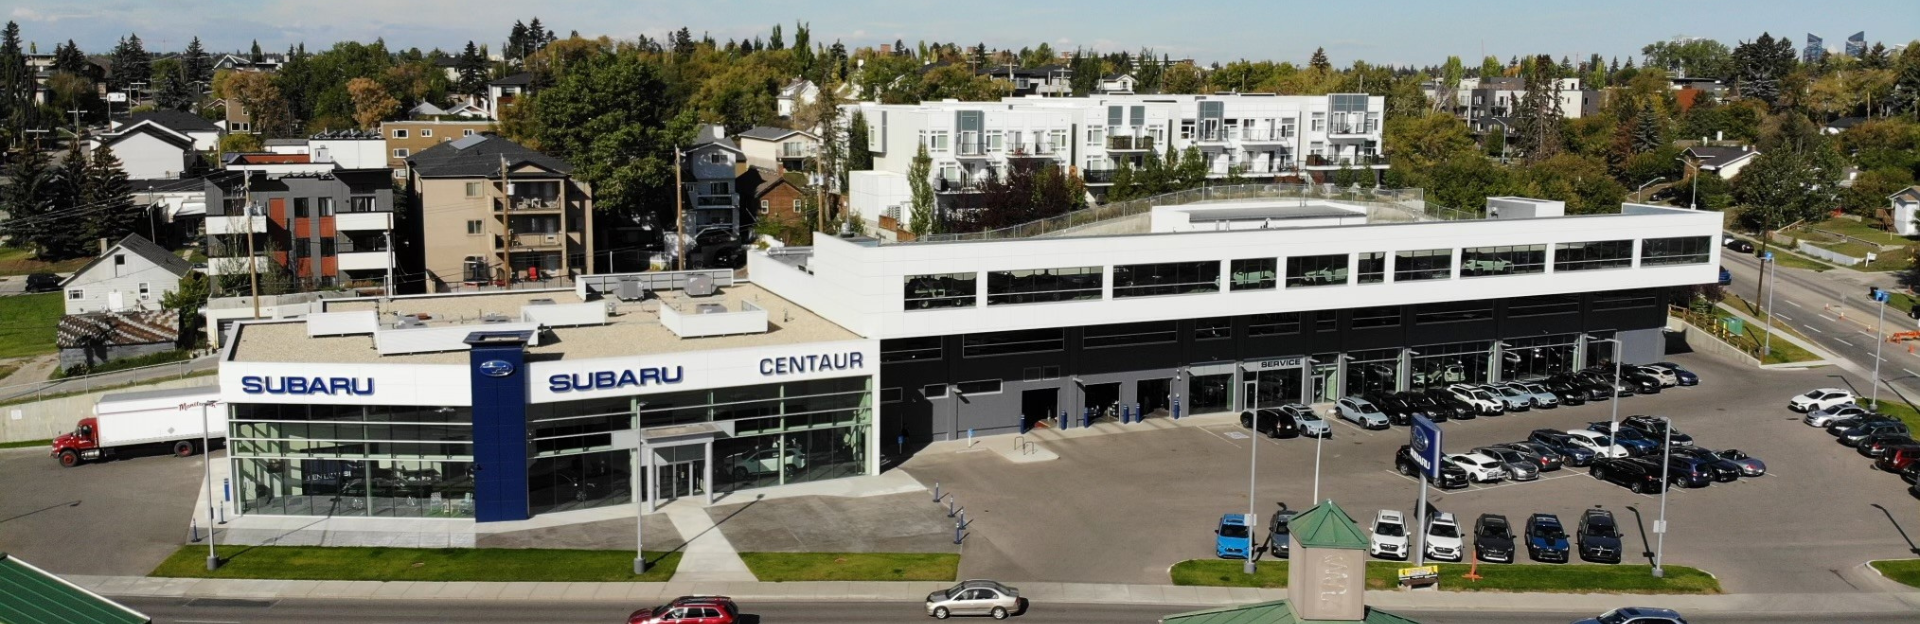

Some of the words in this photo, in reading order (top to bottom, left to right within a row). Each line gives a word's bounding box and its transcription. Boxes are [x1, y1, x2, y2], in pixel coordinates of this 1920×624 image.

[759, 351, 863, 376] CENTAUR
[1261, 358, 1300, 368] SERVICE
[241, 376, 374, 395] SUBARU
[549, 366, 683, 393] SUBARU
